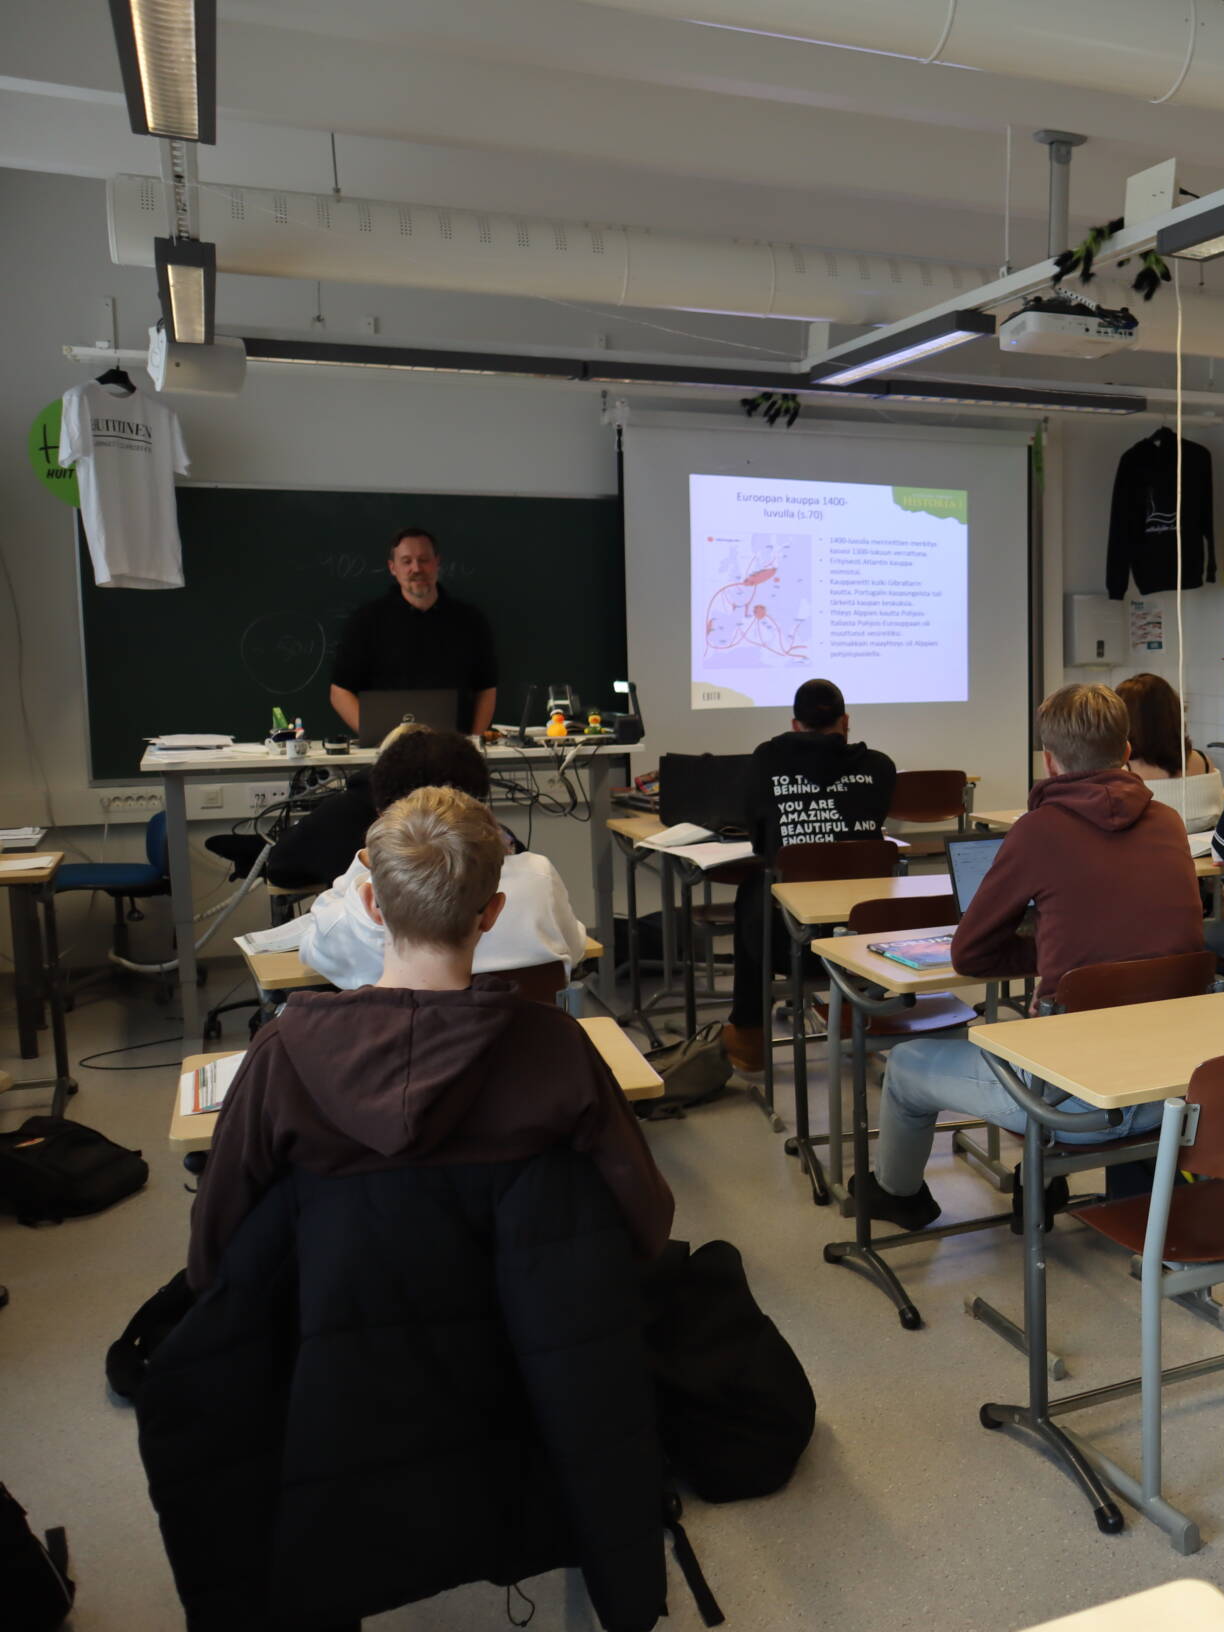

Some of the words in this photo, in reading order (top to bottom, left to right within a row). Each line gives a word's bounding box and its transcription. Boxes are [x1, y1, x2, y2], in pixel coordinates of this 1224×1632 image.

[46, 468, 76, 479] HUIT
[736, 491, 783, 504] Euroopan
[785, 494, 820, 507] kauppa
[823, 496, 848, 506] 1400-
[763, 508, 795, 519] luvulla
[797, 509, 823, 521] (s.70)
[771, 775, 789, 786] TO
[840, 774, 873, 785] RSON
[773, 784, 820, 796] BEHIND
[777, 801, 803, 814] YOU
[809, 799, 835, 810] ARE
[780, 821, 848, 837] BEAUTIFUL
[854, 820, 876, 832] AND
